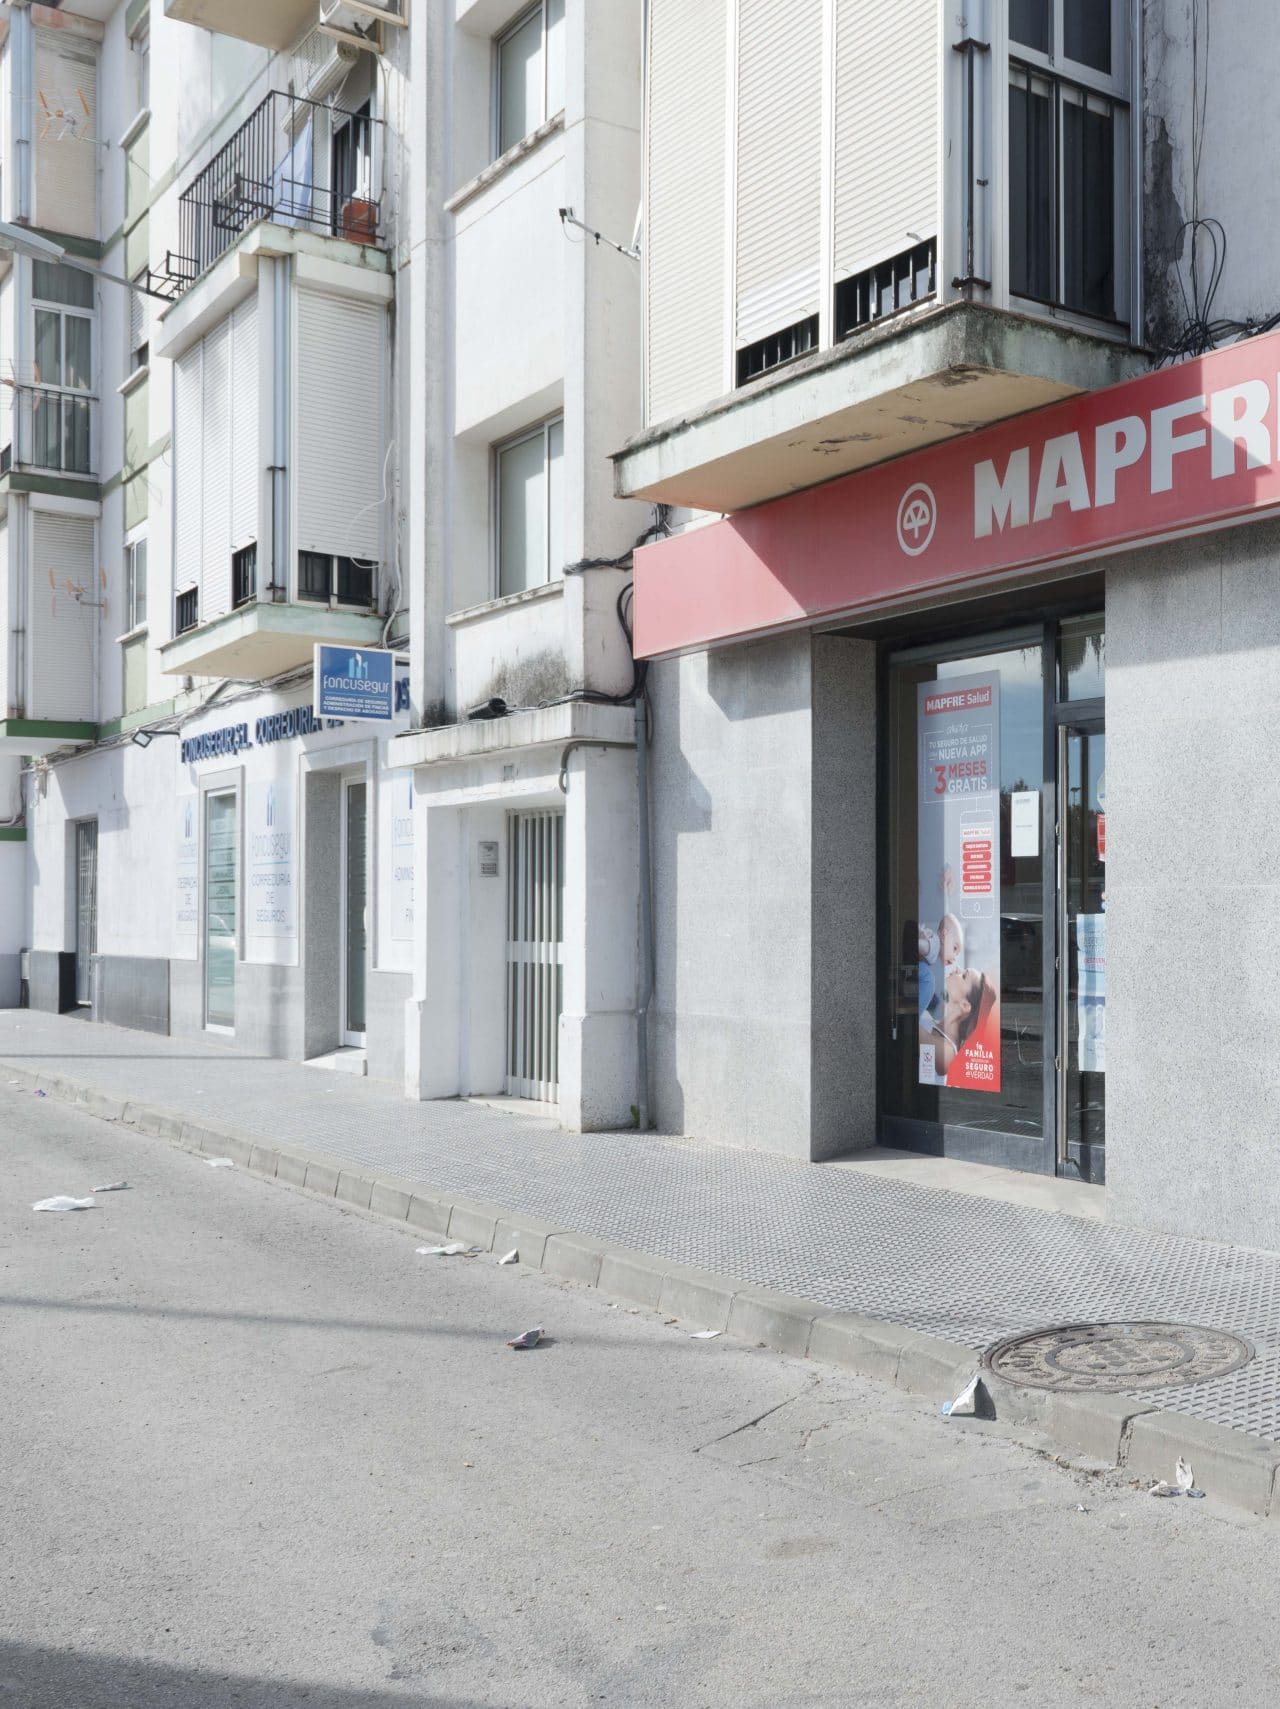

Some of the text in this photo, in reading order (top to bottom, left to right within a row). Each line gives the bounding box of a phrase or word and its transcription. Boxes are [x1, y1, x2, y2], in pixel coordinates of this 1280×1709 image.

[323, 675, 389, 693] foncusegur
[926, 690, 990, 711] MAPFRE Salud
[938, 748, 968, 761] NUEVA
[969, 744, 988, 757] APP
[934, 760, 987, 795] 3 MESES
[948, 776, 988, 793] GRATIS
[965, 1049, 993, 1060] FAMILIA
[965, 1062, 993, 1072] SEGURO
[971, 1071, 993, 1080] VERDAD
